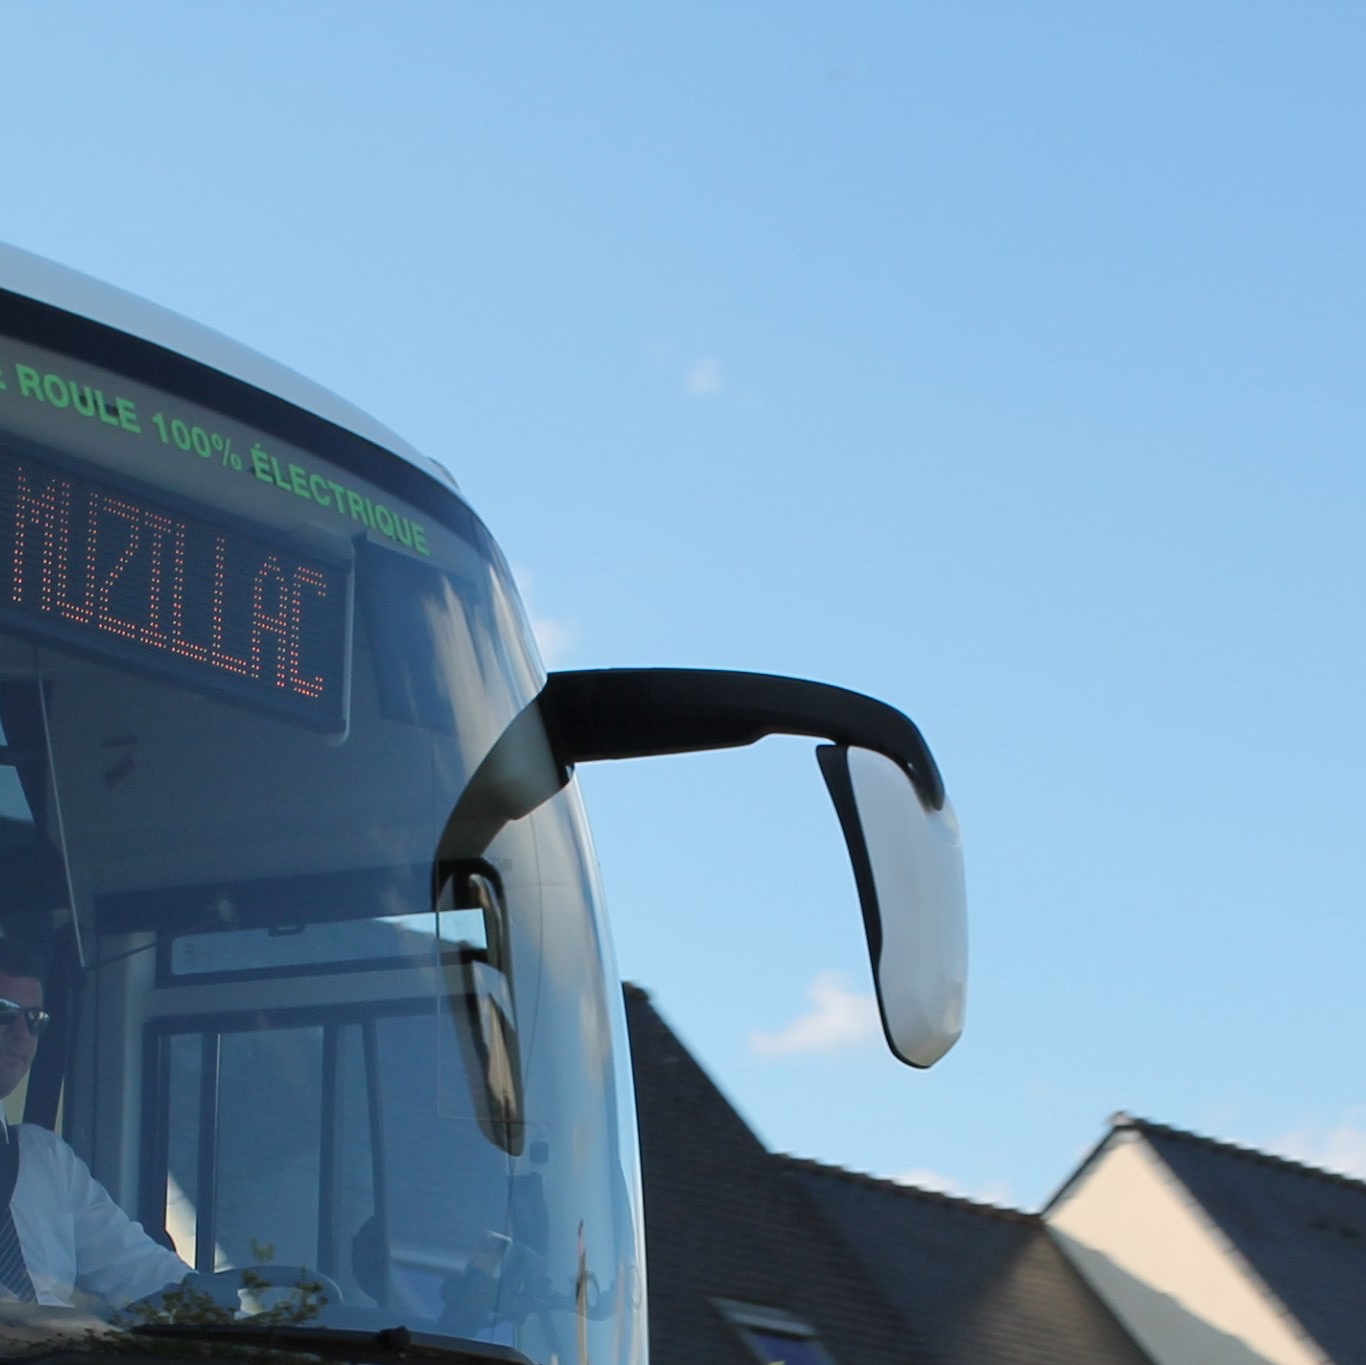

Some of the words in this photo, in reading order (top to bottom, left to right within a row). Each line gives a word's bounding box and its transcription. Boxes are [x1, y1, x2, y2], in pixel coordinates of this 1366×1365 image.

[15, 364, 141, 433] ROULE
[151, 413, 242, 470] 100%
[250, 443, 430, 556] ÉLECTRIQUE
[13, 467, 327, 697] MUZILLAC
